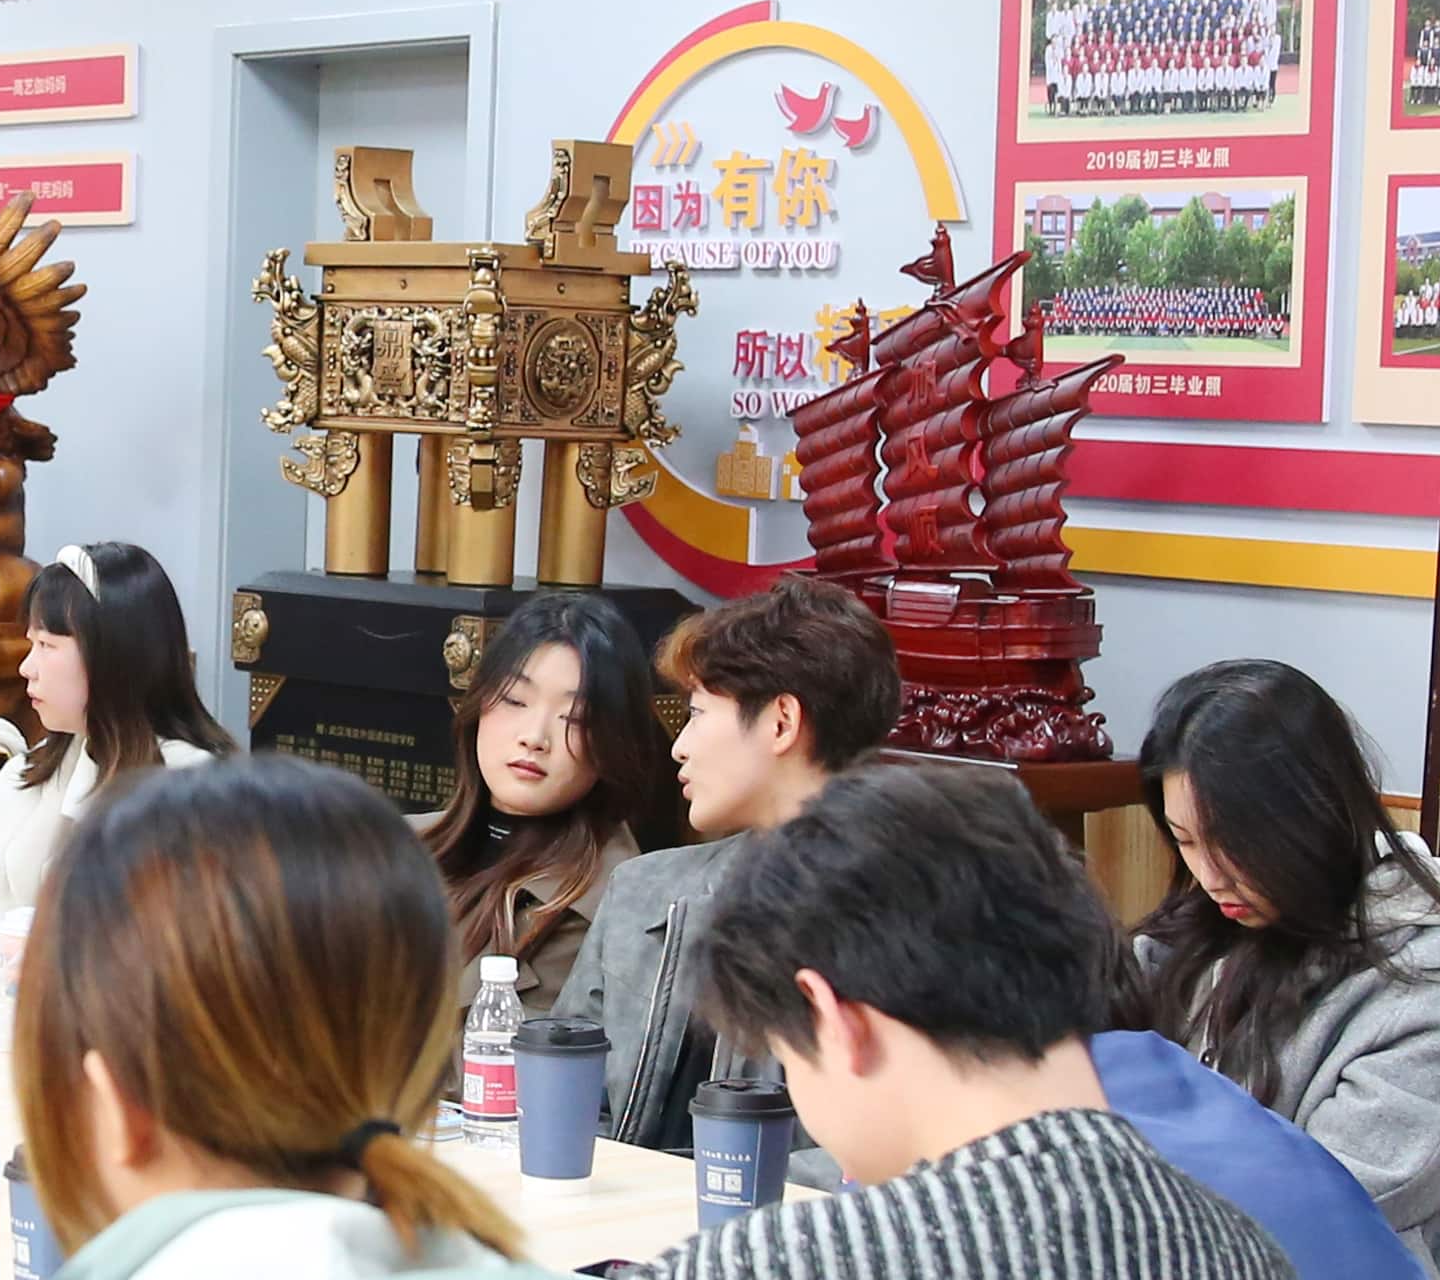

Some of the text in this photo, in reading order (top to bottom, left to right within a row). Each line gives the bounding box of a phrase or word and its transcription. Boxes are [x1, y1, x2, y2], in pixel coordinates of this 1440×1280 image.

[1086, 146, 1230, 172] 2019届初三毕业照
[633, 147, 832, 230] 因为有你
[744, 242, 777, 265] OF
[777, 242, 833, 265] YOU
[731, 393, 762, 417] SO
